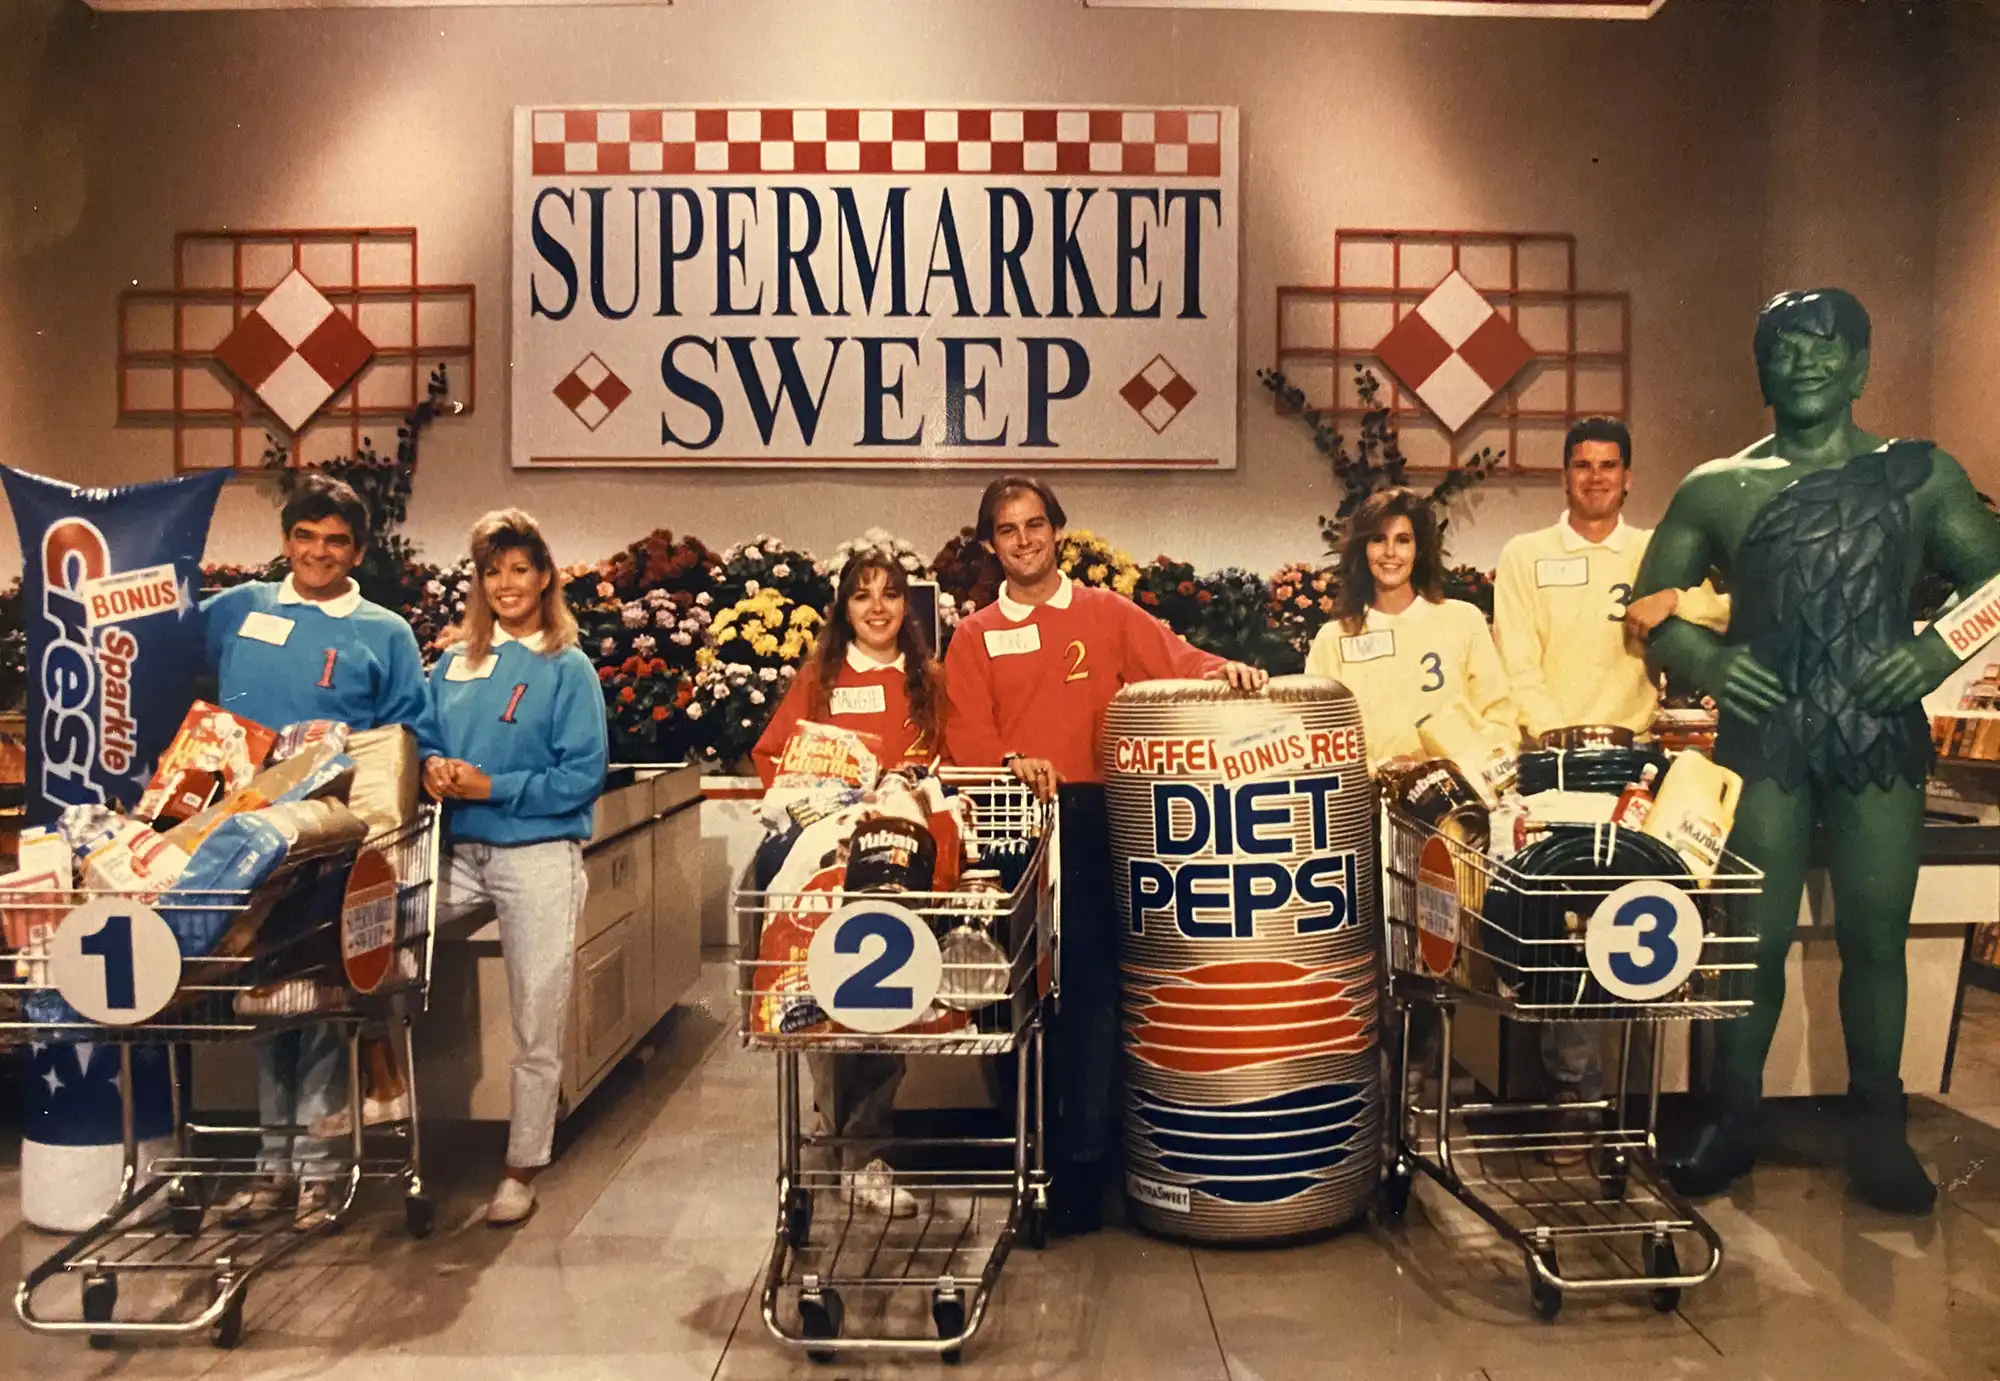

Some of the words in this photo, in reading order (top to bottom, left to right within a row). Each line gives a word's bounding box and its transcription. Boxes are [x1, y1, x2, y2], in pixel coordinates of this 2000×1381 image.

[531, 186, 1222, 321] SUPERMARKET
[660, 335, 1091, 450] SWEEP
[91, 580, 177, 619] BONUS
[1607, 583, 1633, 622] 3
[1948, 595, 2000, 651] BONU
[41, 516, 112, 808] Crest
[316, 648, 339, 690] 1
[1063, 639, 1090, 684] 2
[1420, 651, 1445, 692] 3
[103, 629, 136, 771] Sparkle
[498, 683, 528, 724] 1
[903, 718, 929, 756] 2
[1116, 738, 1218, 772] CAFFEI
[1310, 729, 1358, 764] REE
[1223, 735, 1305, 780] BONUS
[1152, 776, 1340, 855] DIET
[1129, 853, 1359, 938] PEPSI
[81, 915, 136, 1010] 1
[833, 912, 915, 1010] 2
[1608, 895, 1679, 985] 3
